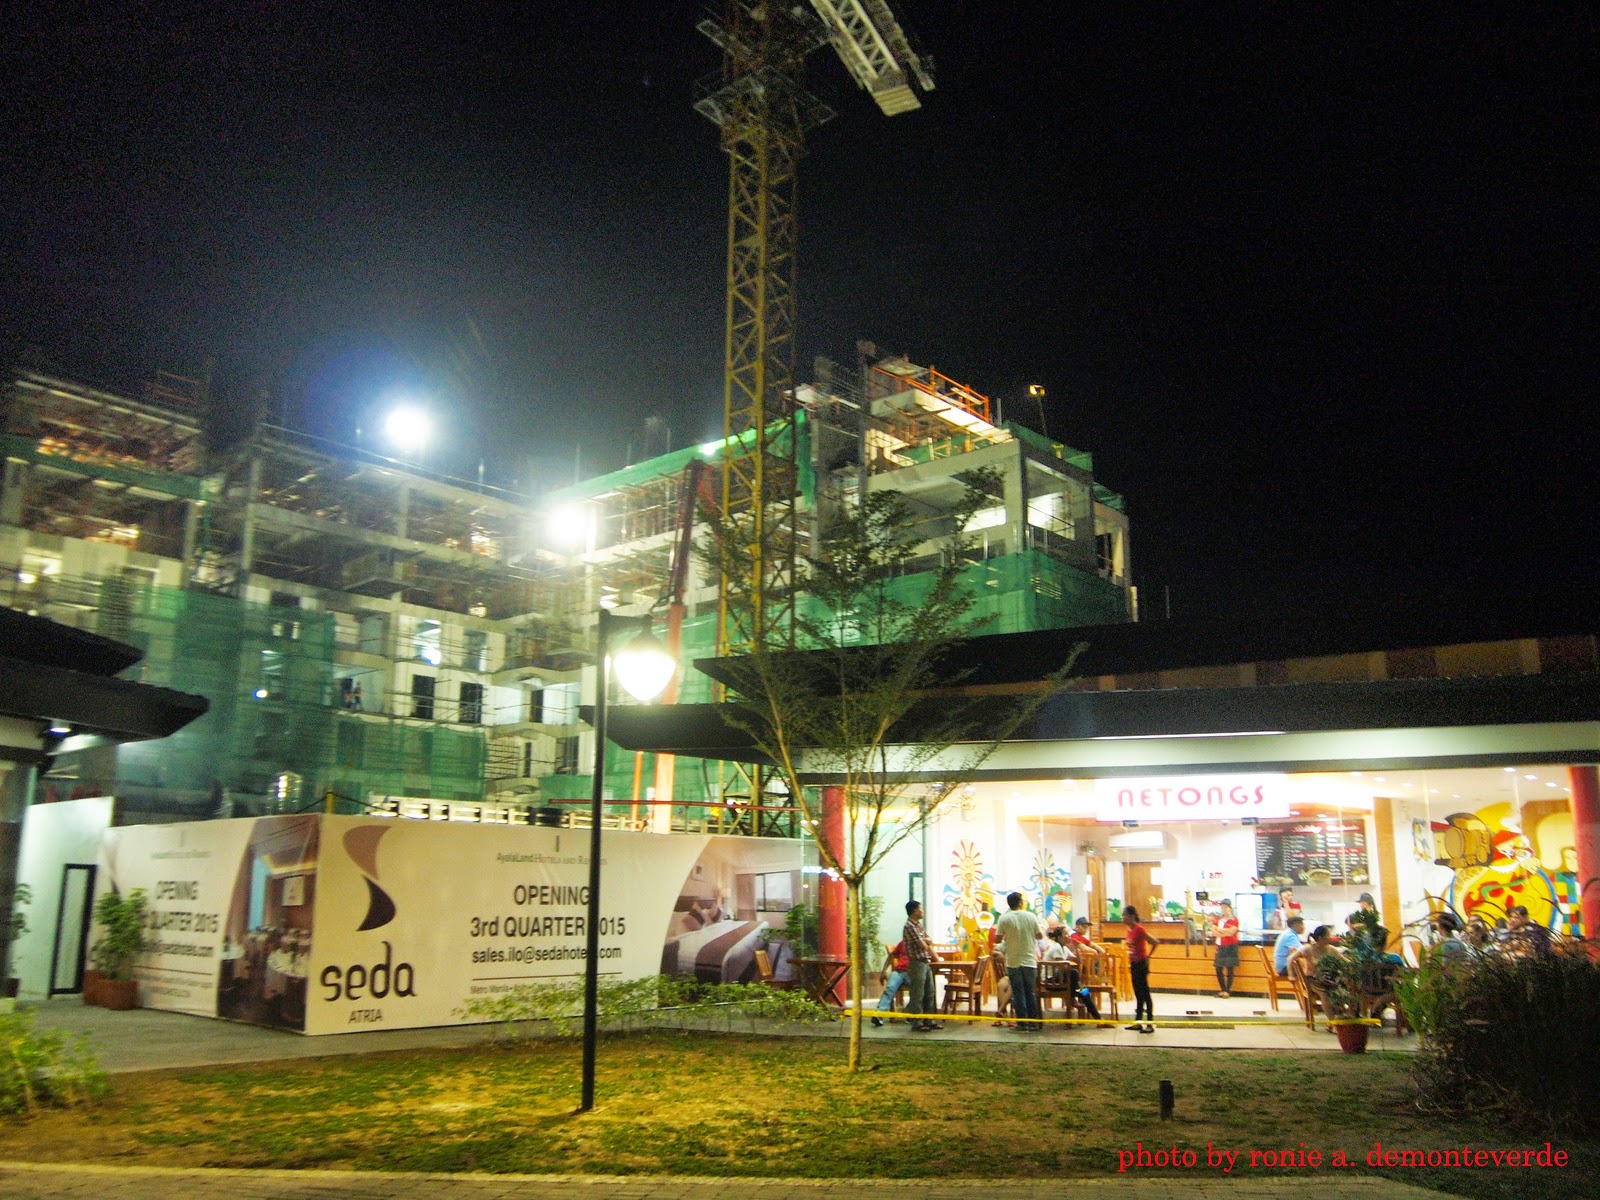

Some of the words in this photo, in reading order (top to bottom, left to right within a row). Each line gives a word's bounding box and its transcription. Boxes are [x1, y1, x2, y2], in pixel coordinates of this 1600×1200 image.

[1118, 785, 1264, 808] NETONGS
[513, 885, 591, 905] OPENING
[470, 916, 499, 938] 3rd
[503, 916, 585, 937] QUARTER
[591, 917, 626, 936] 015
[320, 941, 417, 1001] seda
[349, 1008, 383, 1024] ATRIA
